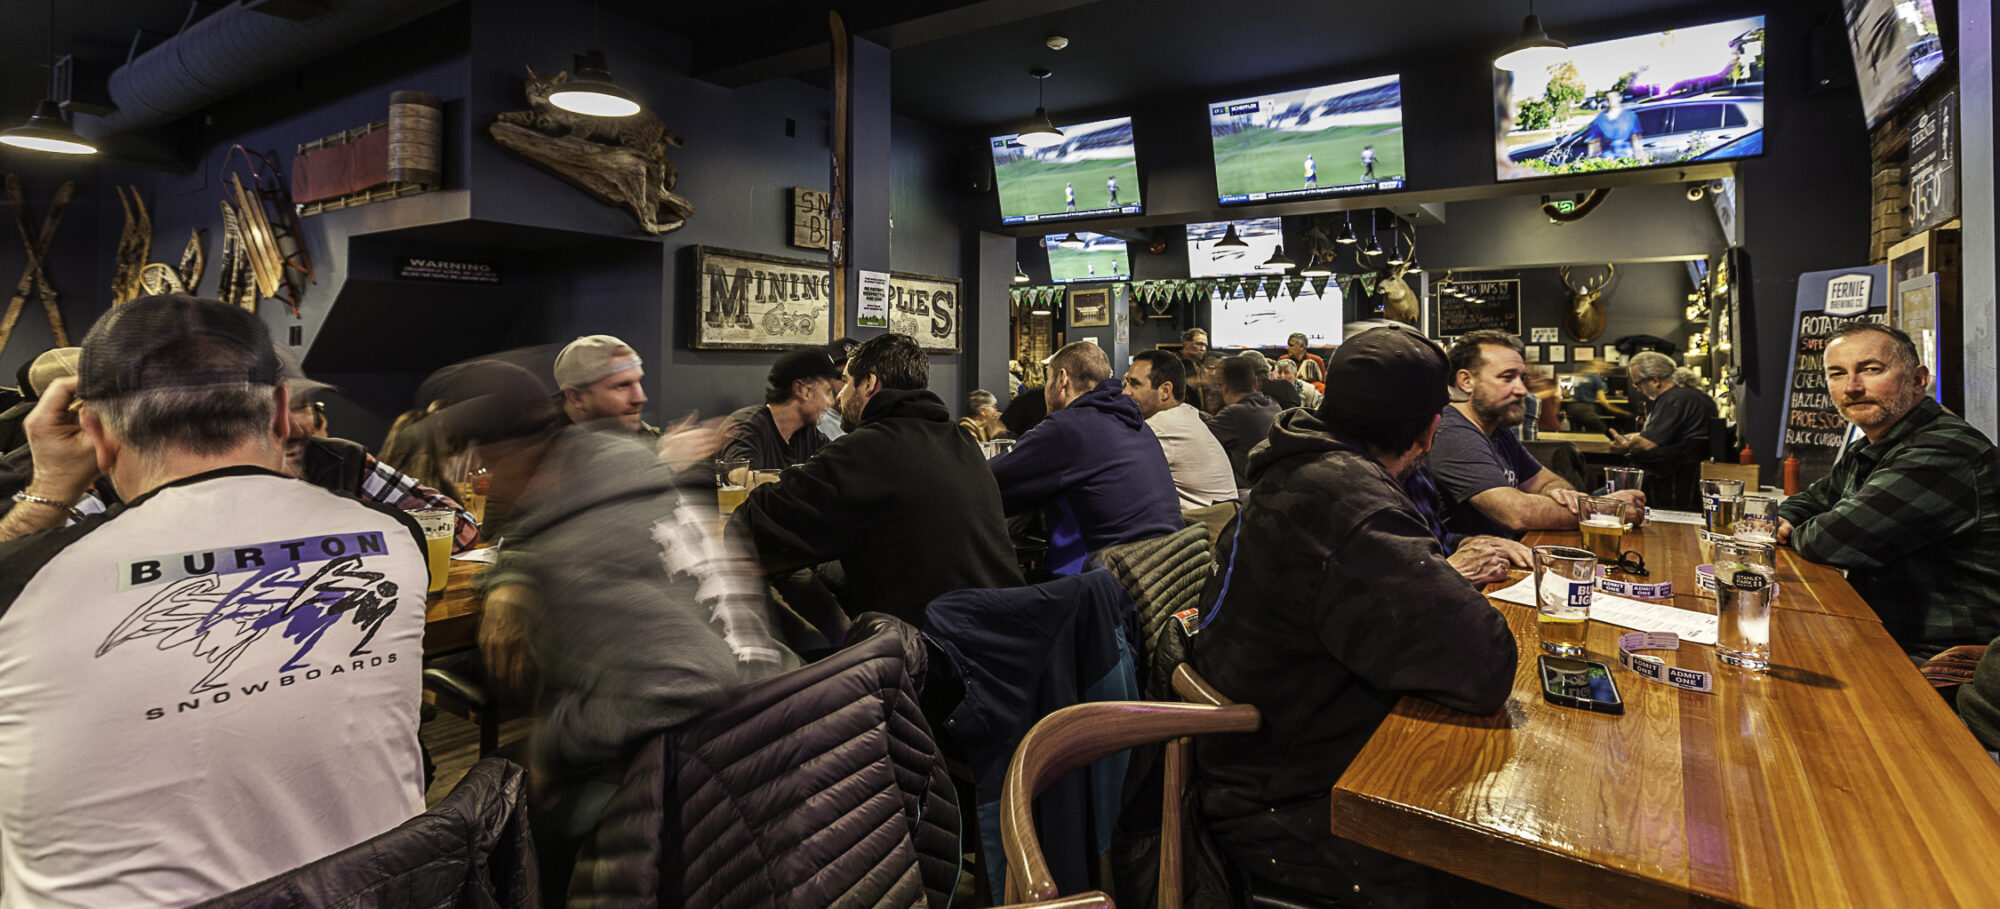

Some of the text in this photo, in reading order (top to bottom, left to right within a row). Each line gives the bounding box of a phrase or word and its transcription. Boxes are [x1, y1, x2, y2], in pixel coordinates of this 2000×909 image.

[801, 191, 829, 216] SN
[409, 259, 490, 271] WARNING
[1832, 280, 1865, 298] FERNIE
[1795, 372, 1827, 389] CREA
[1785, 428, 1812, 444] BLACK
[131, 534, 382, 586] BURTON
[1577, 585, 1592, 595] BU
[1603, 580, 1624, 589] ADMIT
[1606, 585, 1620, 593] ONE
[1570, 595, 1592, 605] LIG
[1634, 658, 1657, 671] ADMIT
[1636, 665, 1653, 676] ONE
[1670, 670, 1702, 680] ADMIT
[145, 653, 398, 720] SNOWBOARDS
[1675, 677, 1697, 686] ONE
